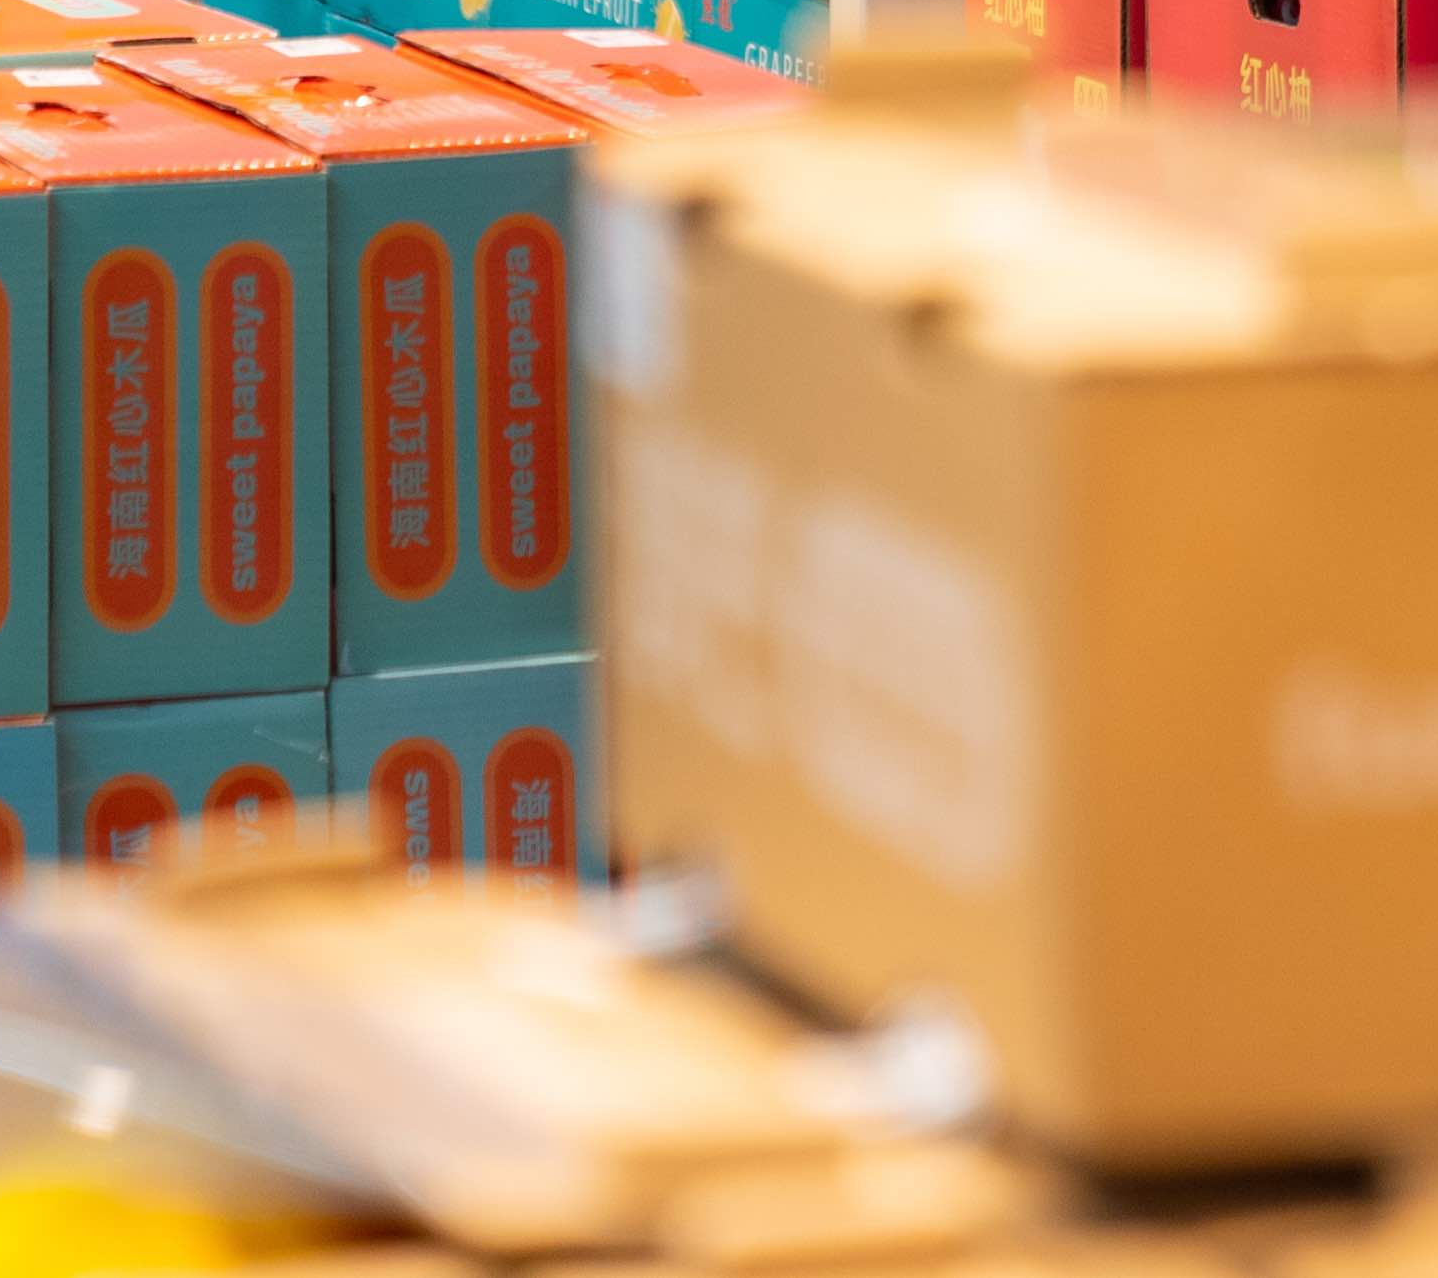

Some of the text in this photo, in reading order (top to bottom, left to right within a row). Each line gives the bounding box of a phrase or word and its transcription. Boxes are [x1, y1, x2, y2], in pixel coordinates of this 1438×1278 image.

[1240, 53, 1312, 124] 红心柚
[107, 299, 150, 580] 海南红心木瓜
[226, 273, 265, 591] sweet papaya
[384, 272, 429, 550] 海南红心木瓜
[503, 245, 542, 559] sweet papaya
